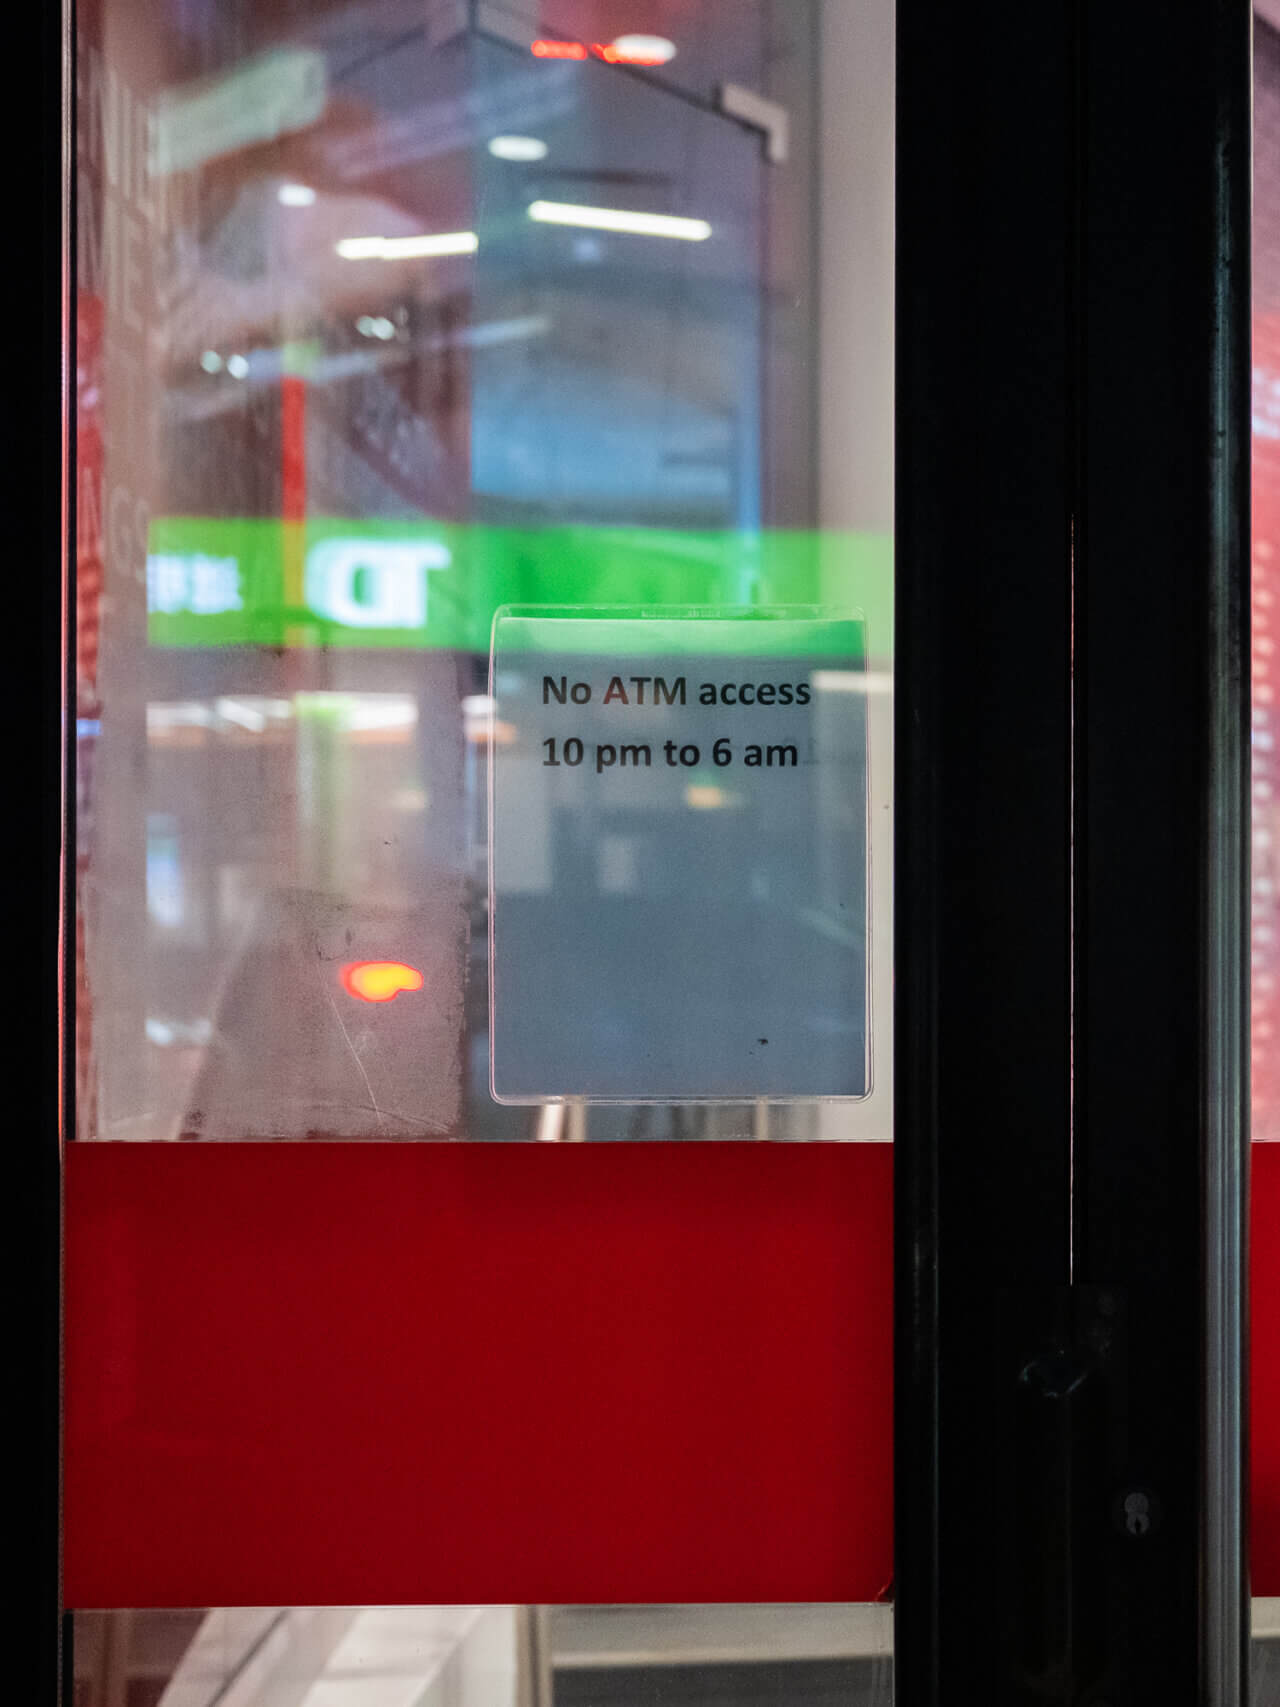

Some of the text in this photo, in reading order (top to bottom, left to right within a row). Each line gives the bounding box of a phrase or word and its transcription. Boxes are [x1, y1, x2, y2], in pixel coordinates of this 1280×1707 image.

[543, 676, 810, 705] No ATM access
[544, 738, 797, 773] 10 pm to 6 am
